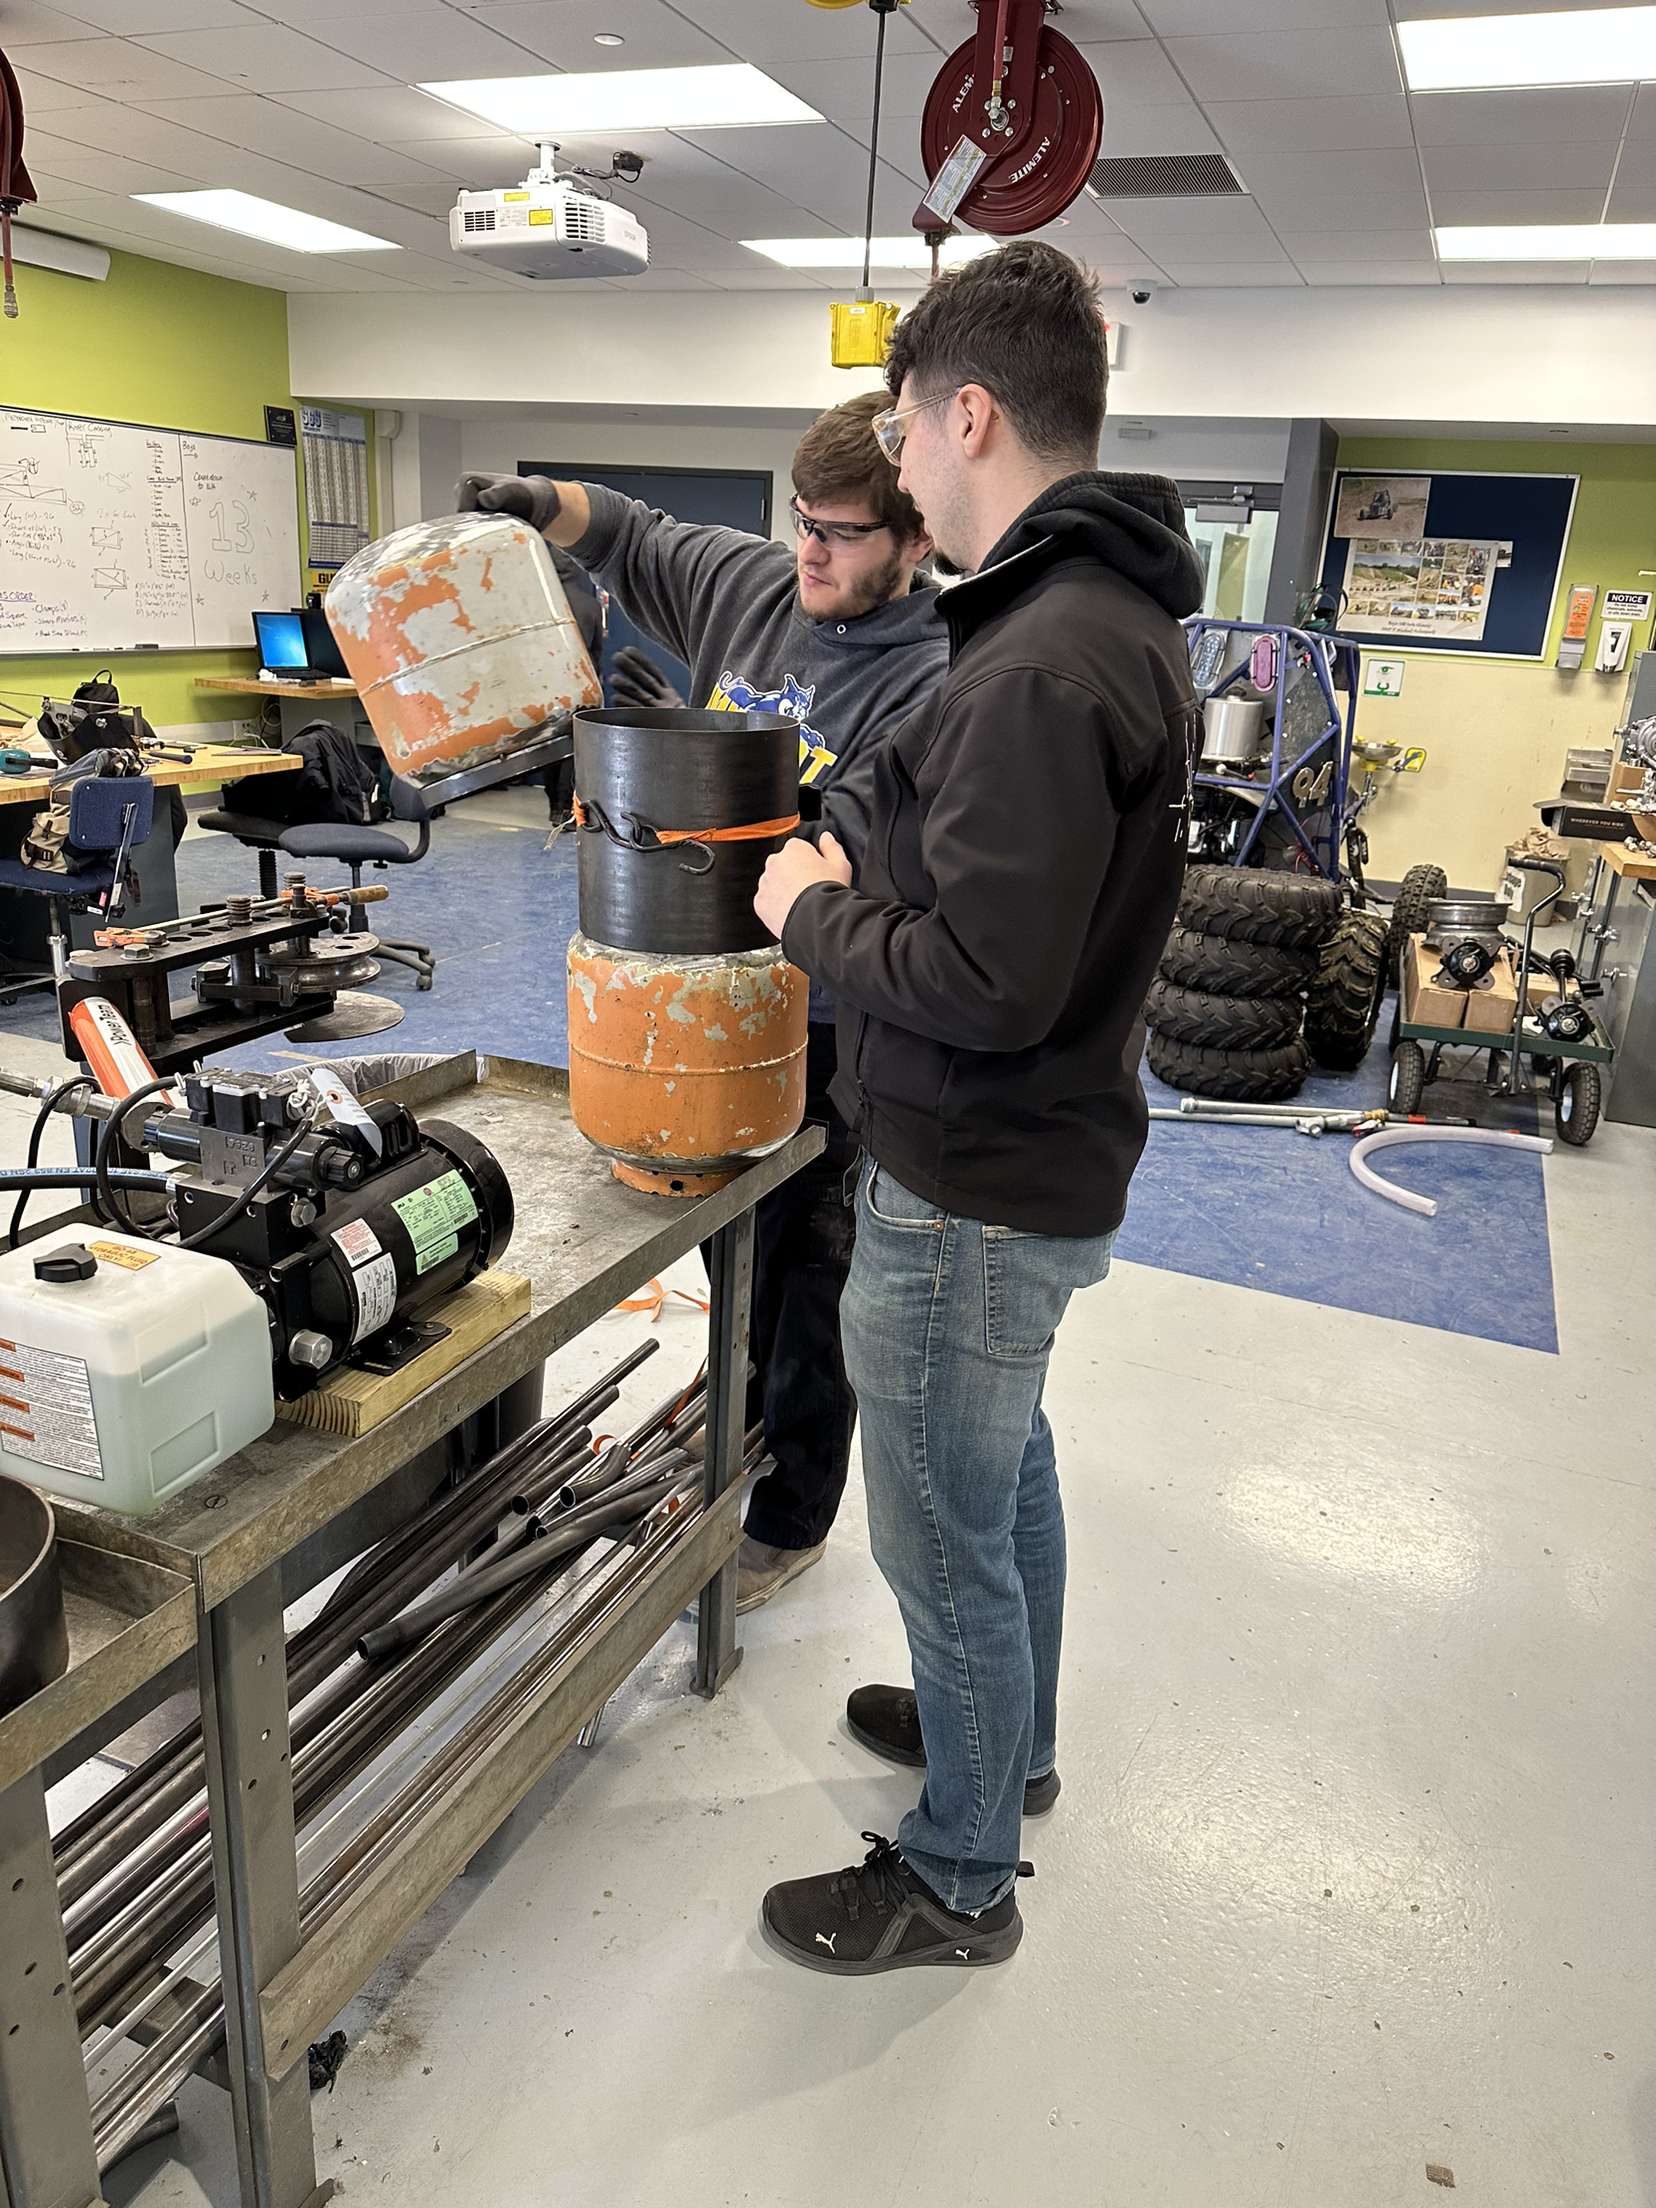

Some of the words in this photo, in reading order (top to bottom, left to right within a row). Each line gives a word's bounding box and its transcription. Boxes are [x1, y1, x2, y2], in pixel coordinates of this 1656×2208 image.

[952, 73, 974, 113] ALEM
[1008, 136, 1051, 184] ALEMITE
[209, 500, 255, 554] 13
[204, 559, 258, 586] Weeks
[1612, 594, 1643, 603] NOTICE
